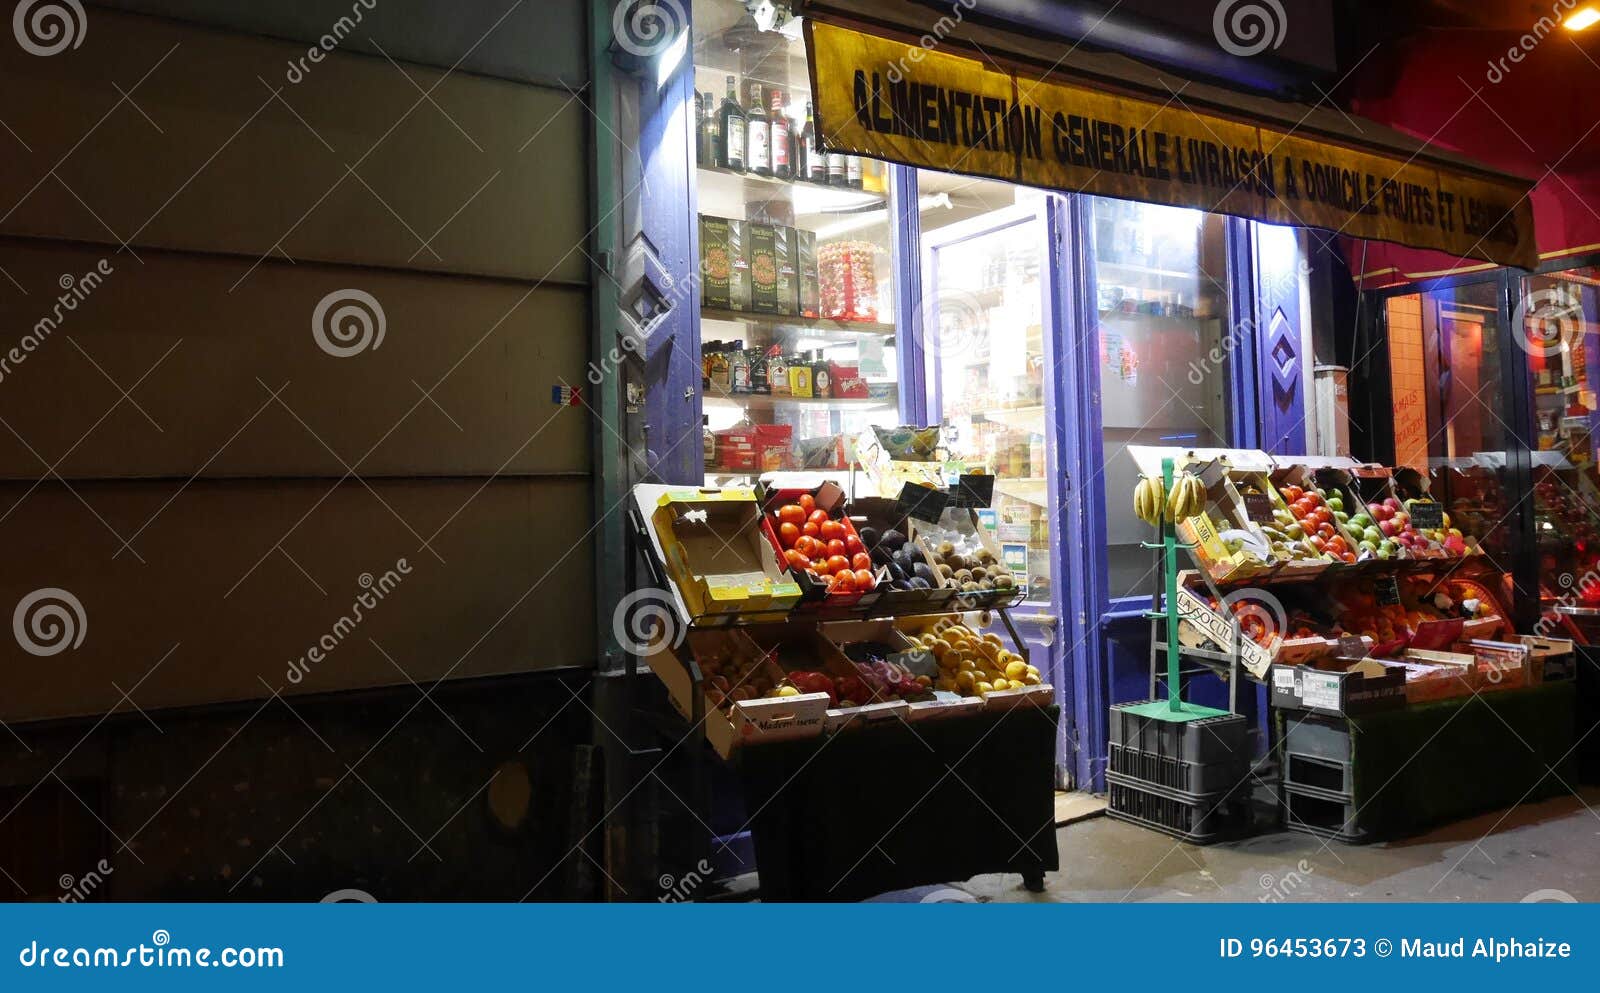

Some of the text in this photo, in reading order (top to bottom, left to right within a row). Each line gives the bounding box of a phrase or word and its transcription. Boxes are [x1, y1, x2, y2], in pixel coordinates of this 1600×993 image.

[854, 70, 1042, 160] ALIMENTATION
[1052, 112, 1170, 181] GENERALE
[1175, 136, 1275, 198] LIVRAISON
[1286, 156, 1299, 201] A
[1303, 160, 1379, 216] DOMICILE
[1381, 177, 1435, 226] FRUITS
[1437, 190, 1456, 233] ET
[1178, 594, 1259, 662] LA SOCULTE
